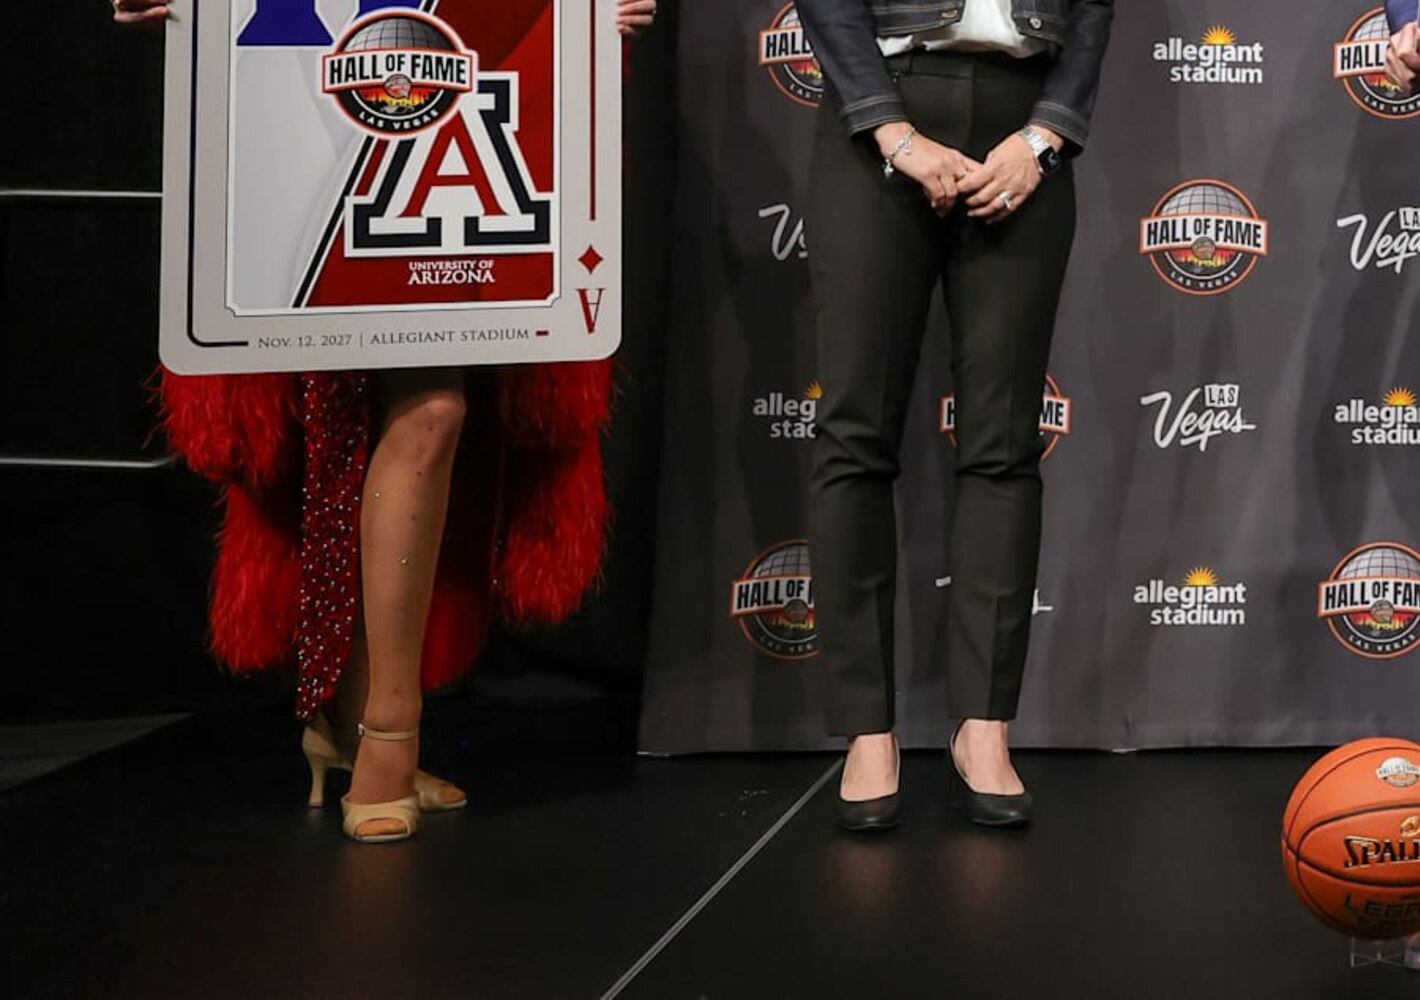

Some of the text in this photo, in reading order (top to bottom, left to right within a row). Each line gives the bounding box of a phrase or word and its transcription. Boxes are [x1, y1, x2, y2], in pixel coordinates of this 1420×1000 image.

[1153, 37, 1263, 66] allegiant
[1341, 44, 1384, 71] HALL
[329, 52, 467, 84] HALL OF FAME
[1170, 62, 1263, 83] stadium
[359, 110, 438, 130] LAS VEGAS
[1147, 218, 1261, 248] HALL OF FAME
[407, 268, 496, 285] ARIZONA
[408, 259, 494, 270] UNIVERSITY OF
[577, 287, 606, 334] A
[321, 334, 352, 346] 2027
[370, 330, 456, 345] ALLEGIANT
[460, 329, 529, 342] STADIUM
[1205, 385, 1238, 406] LAS
[1140, 387, 1256, 451] Vegas
[737, 580, 805, 610] HALL OF
[1133, 579, 1246, 609] allegiant
[1325, 582, 1370, 610] HALL
[1372, 581, 1390, 599] OF
[1150, 604, 1245, 626] stadium
